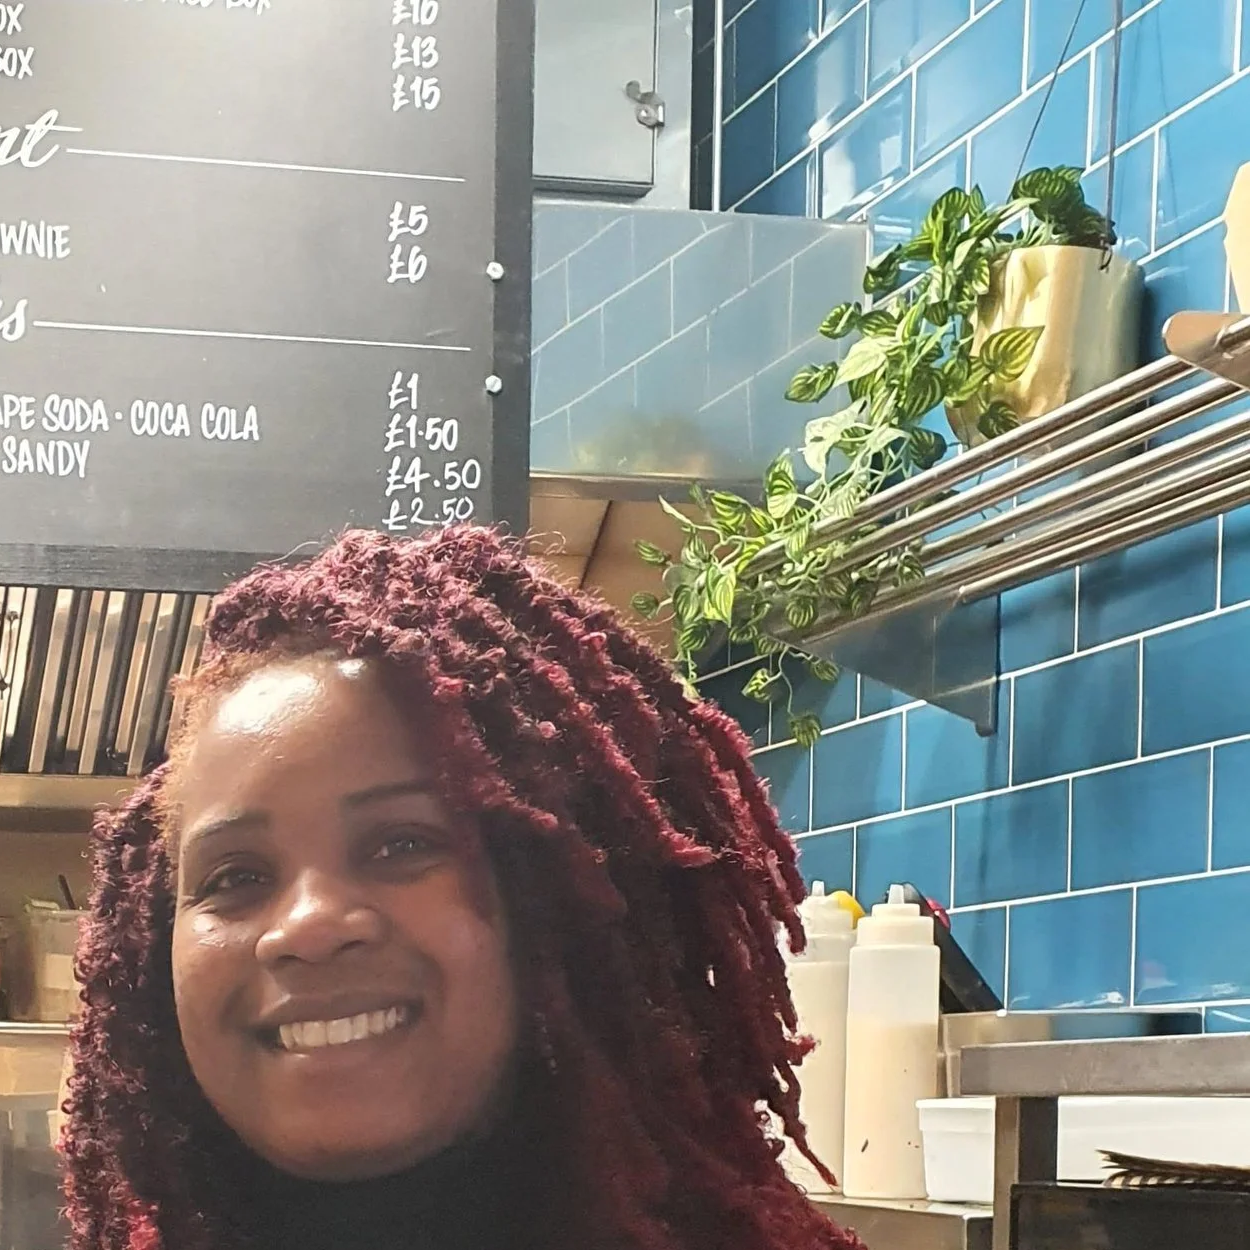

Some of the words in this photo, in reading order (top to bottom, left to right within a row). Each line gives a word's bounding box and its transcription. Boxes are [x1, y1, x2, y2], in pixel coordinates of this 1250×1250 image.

[392, 33, 438, 69] £13
[393, 74, 440, 111] £15
[388, 201, 428, 241] £5
[387, 244, 427, 283] £6
[389, 371, 418, 409] £1
[42, 394, 109, 432] SODA
[131, 400, 190, 436] COCA
[201, 403, 259, 440] COLA
[2, 436, 90, 478] SANDY
